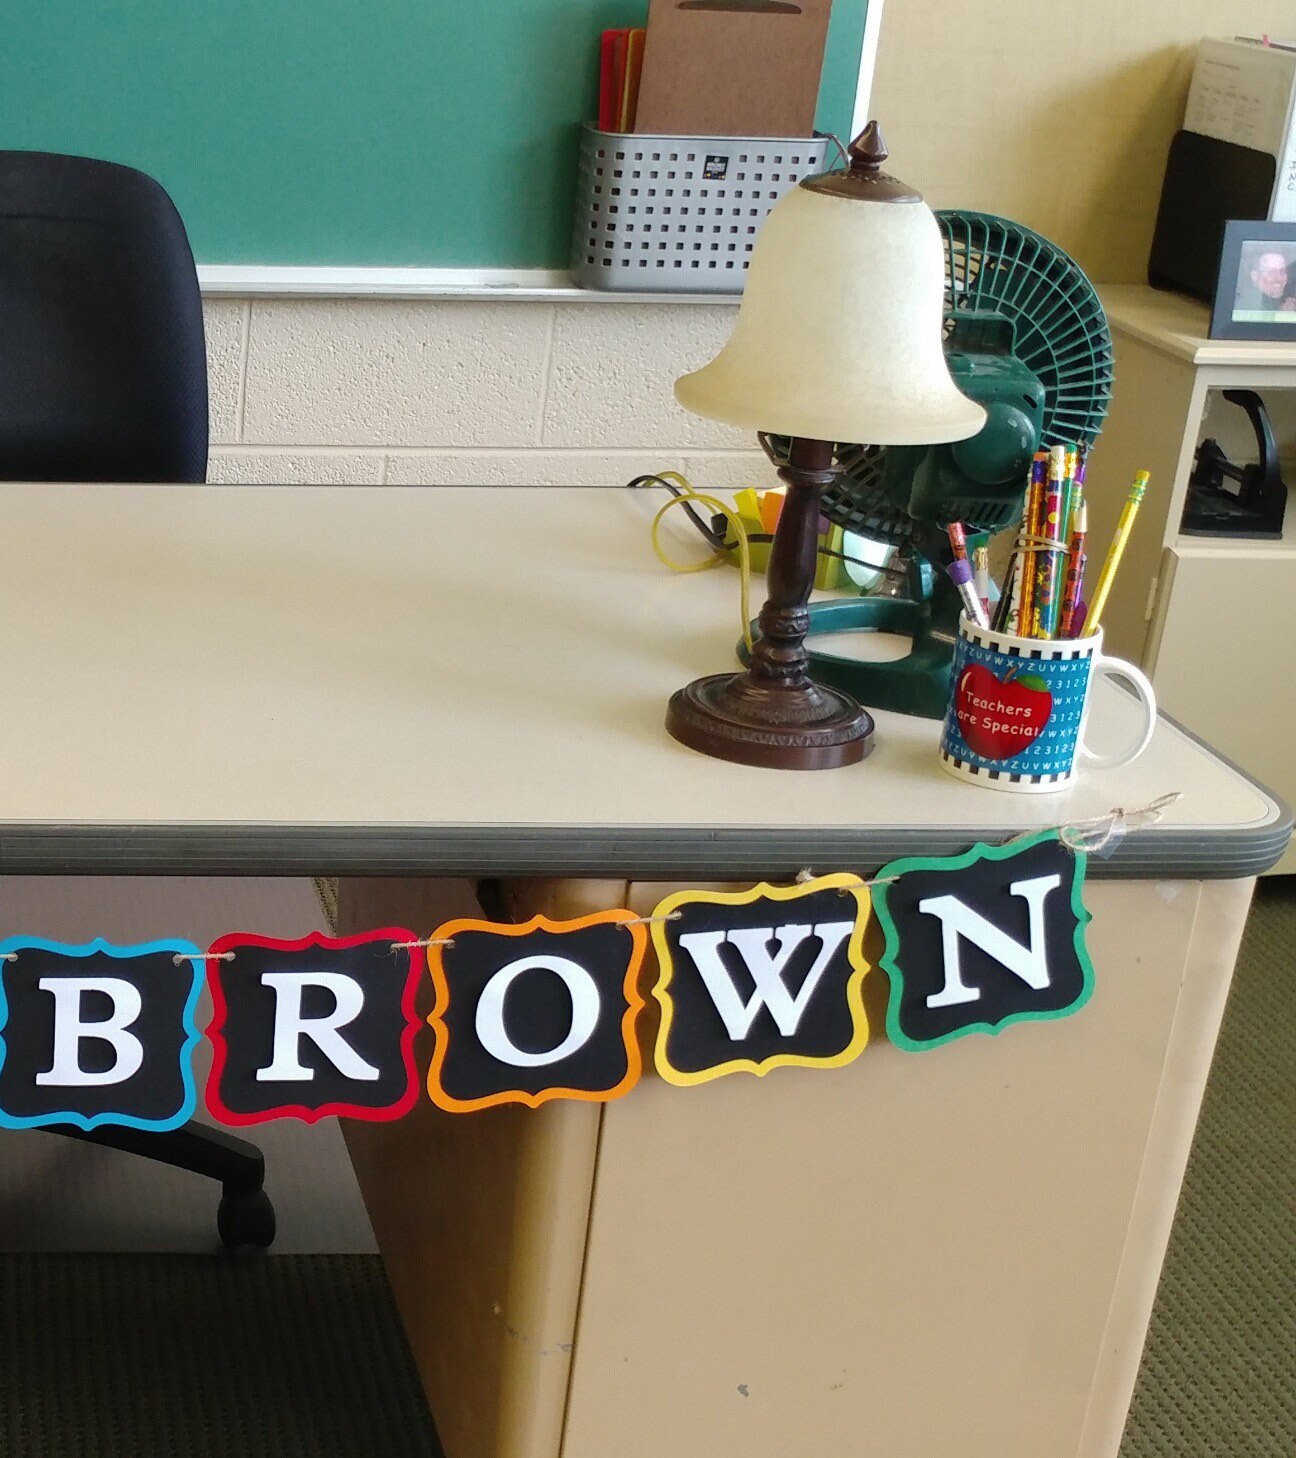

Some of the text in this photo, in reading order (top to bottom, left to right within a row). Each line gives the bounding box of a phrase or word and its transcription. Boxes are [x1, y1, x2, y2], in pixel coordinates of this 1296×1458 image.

[966, 690, 1033, 718] Teachers
[958, 710, 1040, 738] are Special
[35, 873, 1062, 1087] BROWN
